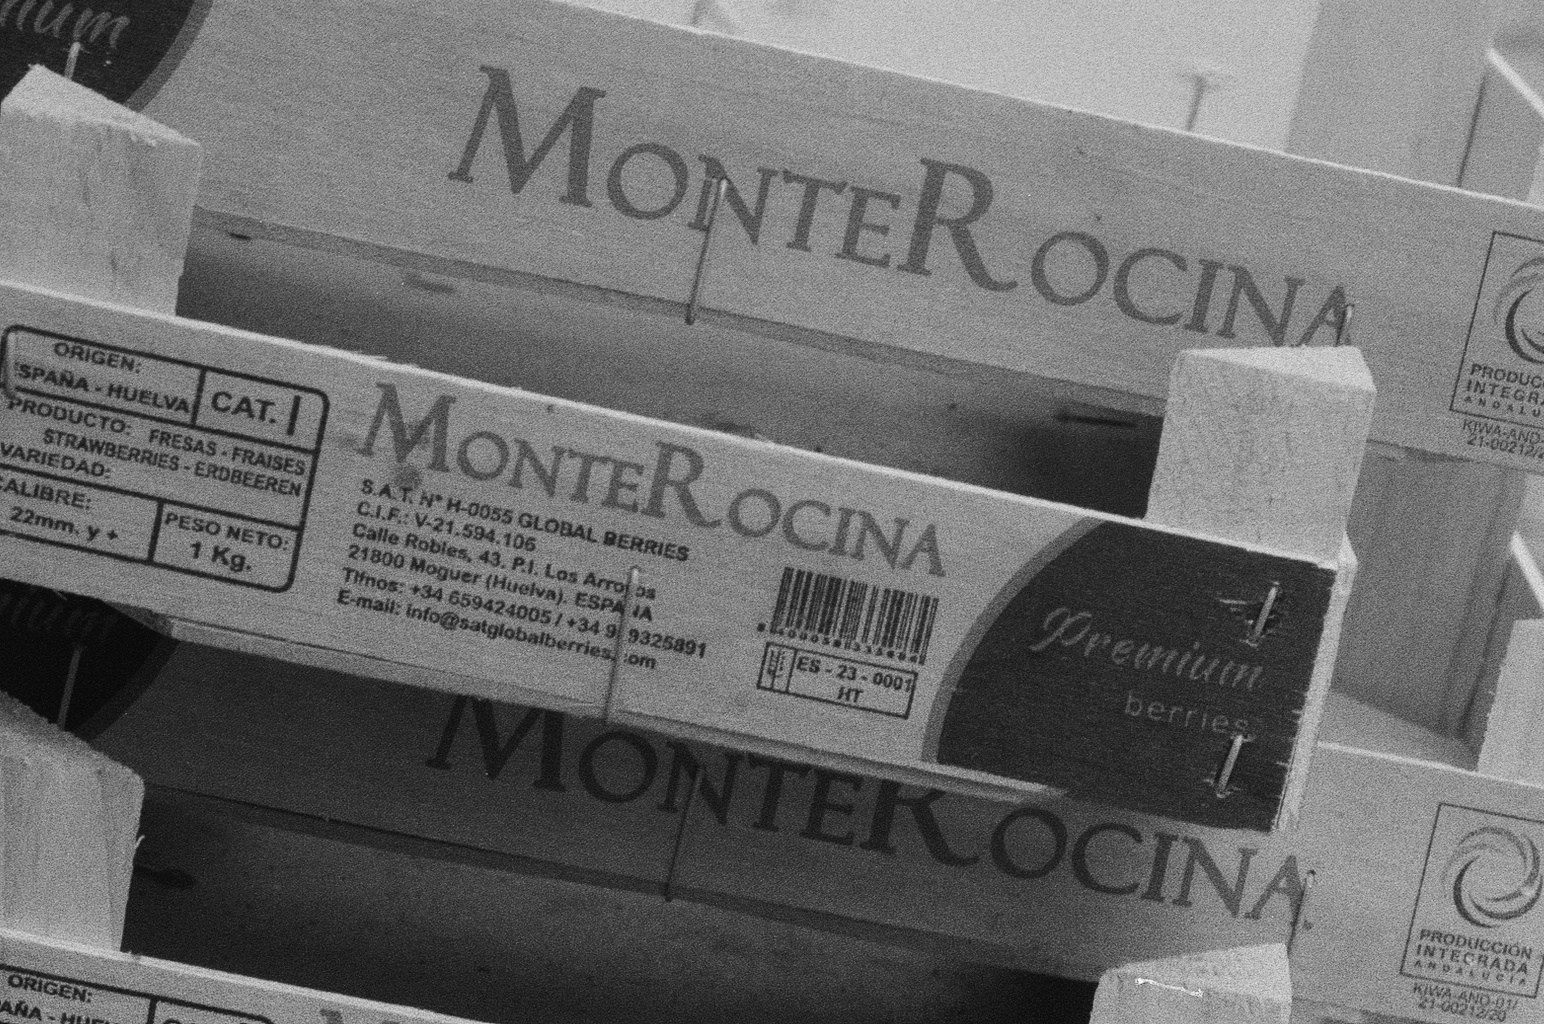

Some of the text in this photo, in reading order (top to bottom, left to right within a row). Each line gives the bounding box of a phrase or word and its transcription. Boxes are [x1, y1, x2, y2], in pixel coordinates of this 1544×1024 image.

[54, 342, 141, 373] ORIGEN:
[107, 384, 190, 413] HUELVA
[210, 391, 276, 424] CAT.
[7, 397, 132, 436] PRODUCTO:
[149, 429, 216, 457] FRESAS
[232, 447, 306, 476] FRAISES
[0, 442, 111, 479] VARIEDAD:
[43, 428, 180, 472] STRAWBERRIES
[194, 462, 301, 497] ERDBEEREN
[0, 478, 92, 511] ALIBRE:
[165, 513, 289, 551] PESO NETO:
[446, 498, 513, 525] H-0055
[517, 512, 598, 545] GLOBAL
[603, 531, 690, 563] BERRIES
[190, 541, 251, 572] 1 Kg.
[348, 544, 405, 569] 21800
[409, 557, 482, 588] Moguer
[352, 523, 400, 547] Calle
[545, 564, 578, 584] Los
[337, 588, 657, 671] E-mail: info@satglobalberries.om
[409, 583, 443, 603] +34
[449, 589, 559, 626] 659424005
[567, 617, 600, 635] +34
[605, 622, 706, 662] 99325891
[1028, 607, 1264, 690] Premium
[796, 656, 820, 675] ES
[836, 665, 857, 681] 23
[873, 671, 913, 693] 0001
[837, 686, 864, 704] HT
[1124, 691, 1250, 734] berries
[1416, 944, 1528, 974] INTEGRADA
[1419, 928, 1532, 960] PRODUCCIÓN
[7, 975, 92, 1003] ORIGEN:
